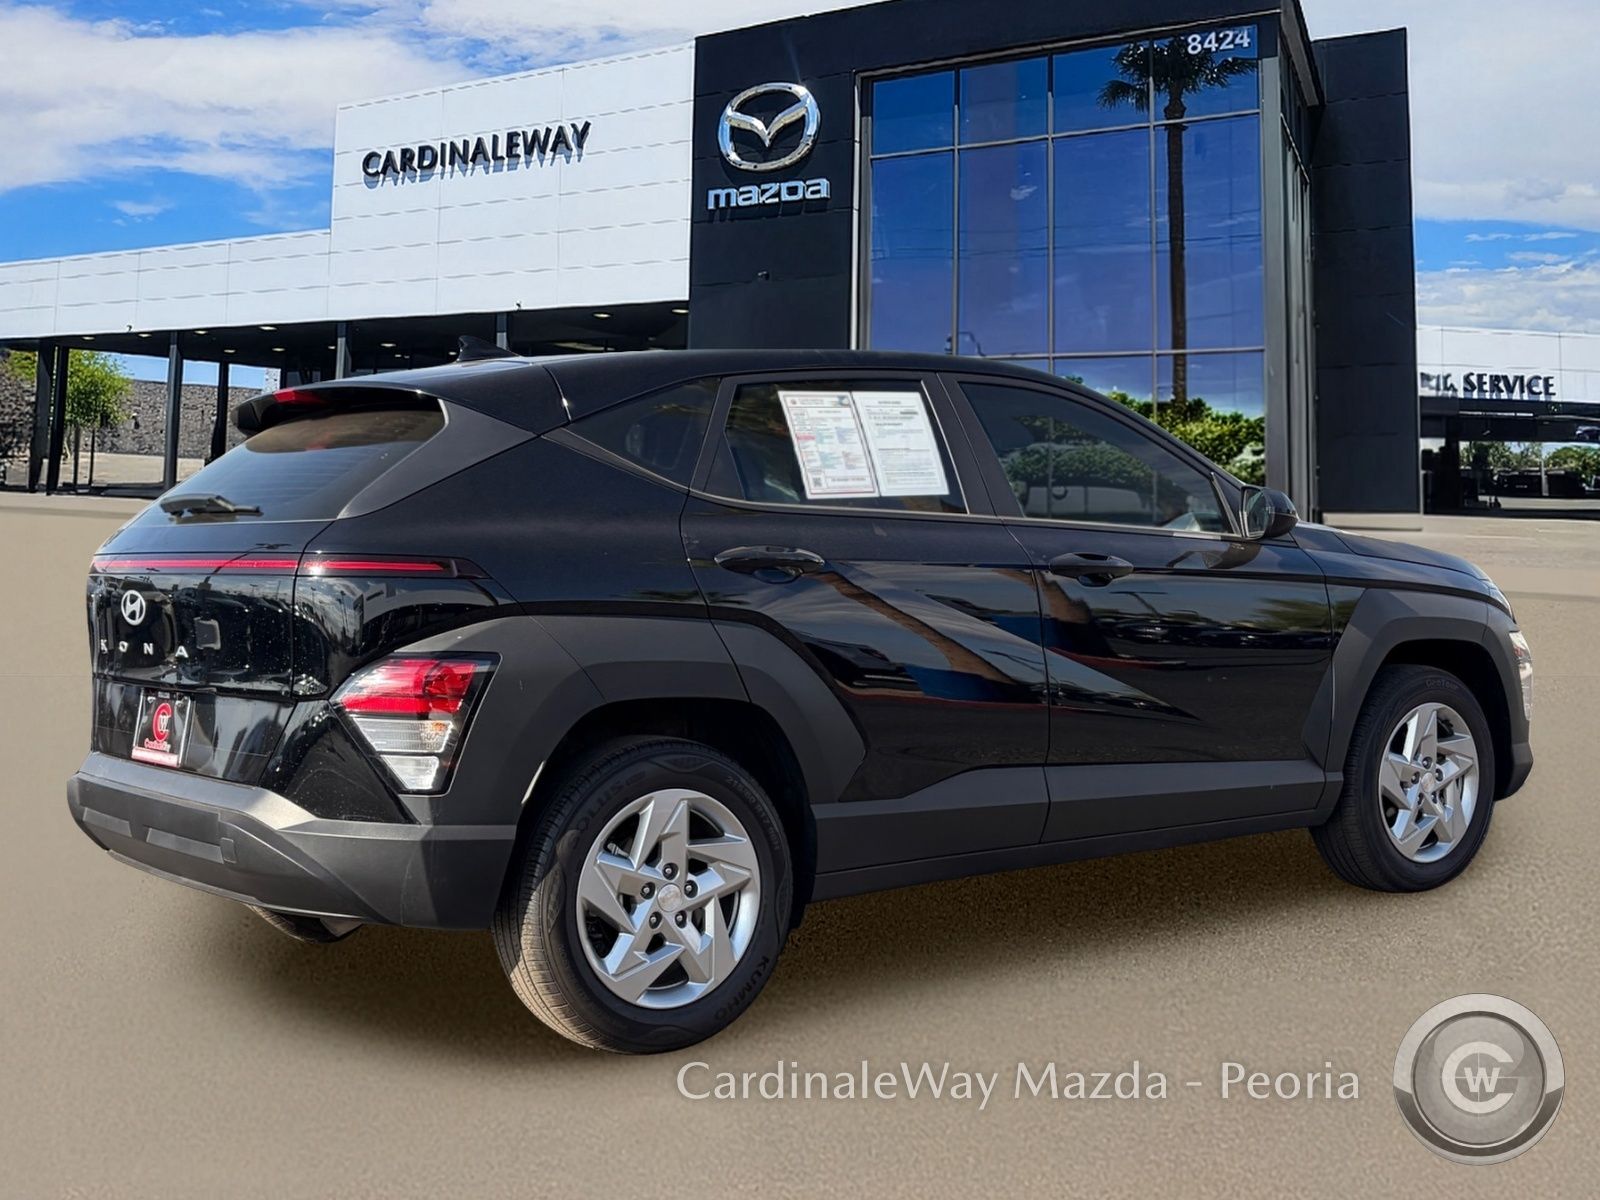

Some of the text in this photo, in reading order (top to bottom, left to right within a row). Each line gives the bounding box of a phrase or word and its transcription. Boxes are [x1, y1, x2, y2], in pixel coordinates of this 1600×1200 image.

[1187, 29, 1251, 55] 8424
[362, 122, 591, 178] CARDINALEWAY
[707, 178, 831, 211] mazda
[1463, 372, 1556, 396] SERVICE
[100, 639, 189, 658] KONA
[714, 955, 770, 1021] KUMHO
